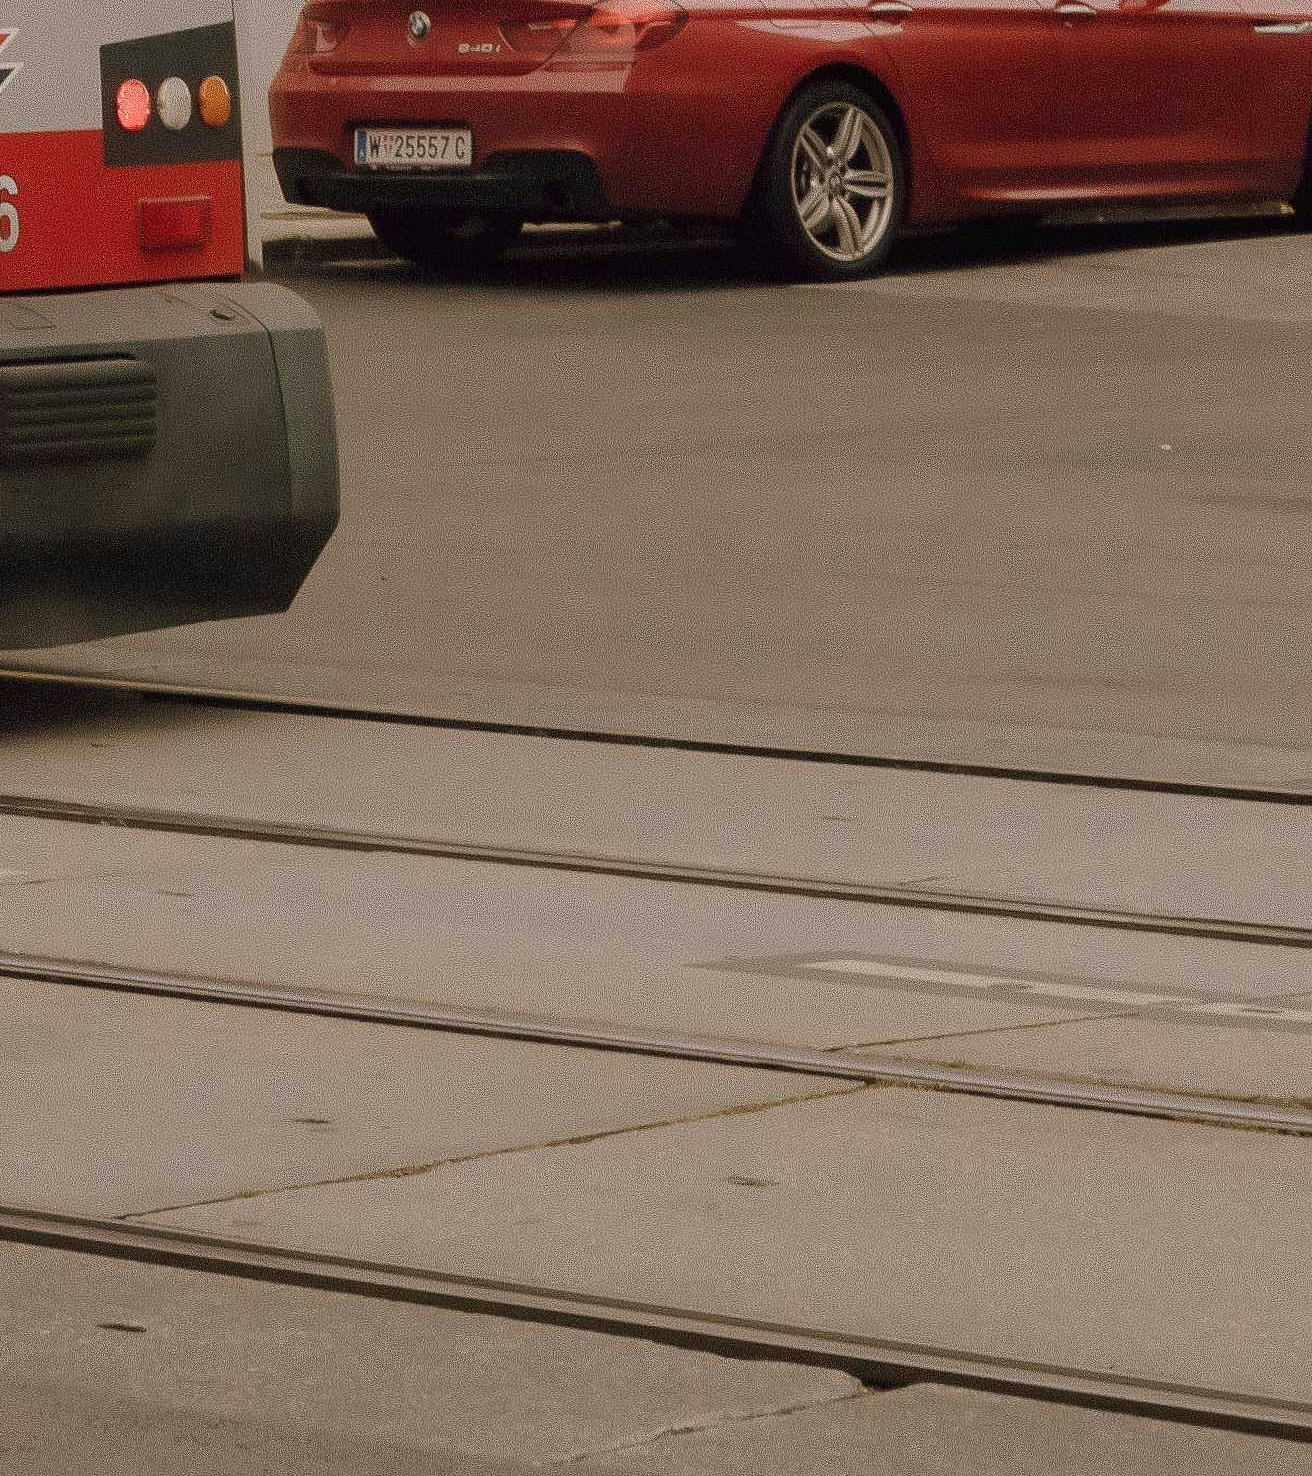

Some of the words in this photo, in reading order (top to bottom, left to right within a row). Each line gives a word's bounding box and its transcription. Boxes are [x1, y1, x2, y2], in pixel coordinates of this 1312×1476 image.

[369, 136, 381, 158] W
[395, 136, 449, 159] 25557
[455, 136, 465, 159] C
